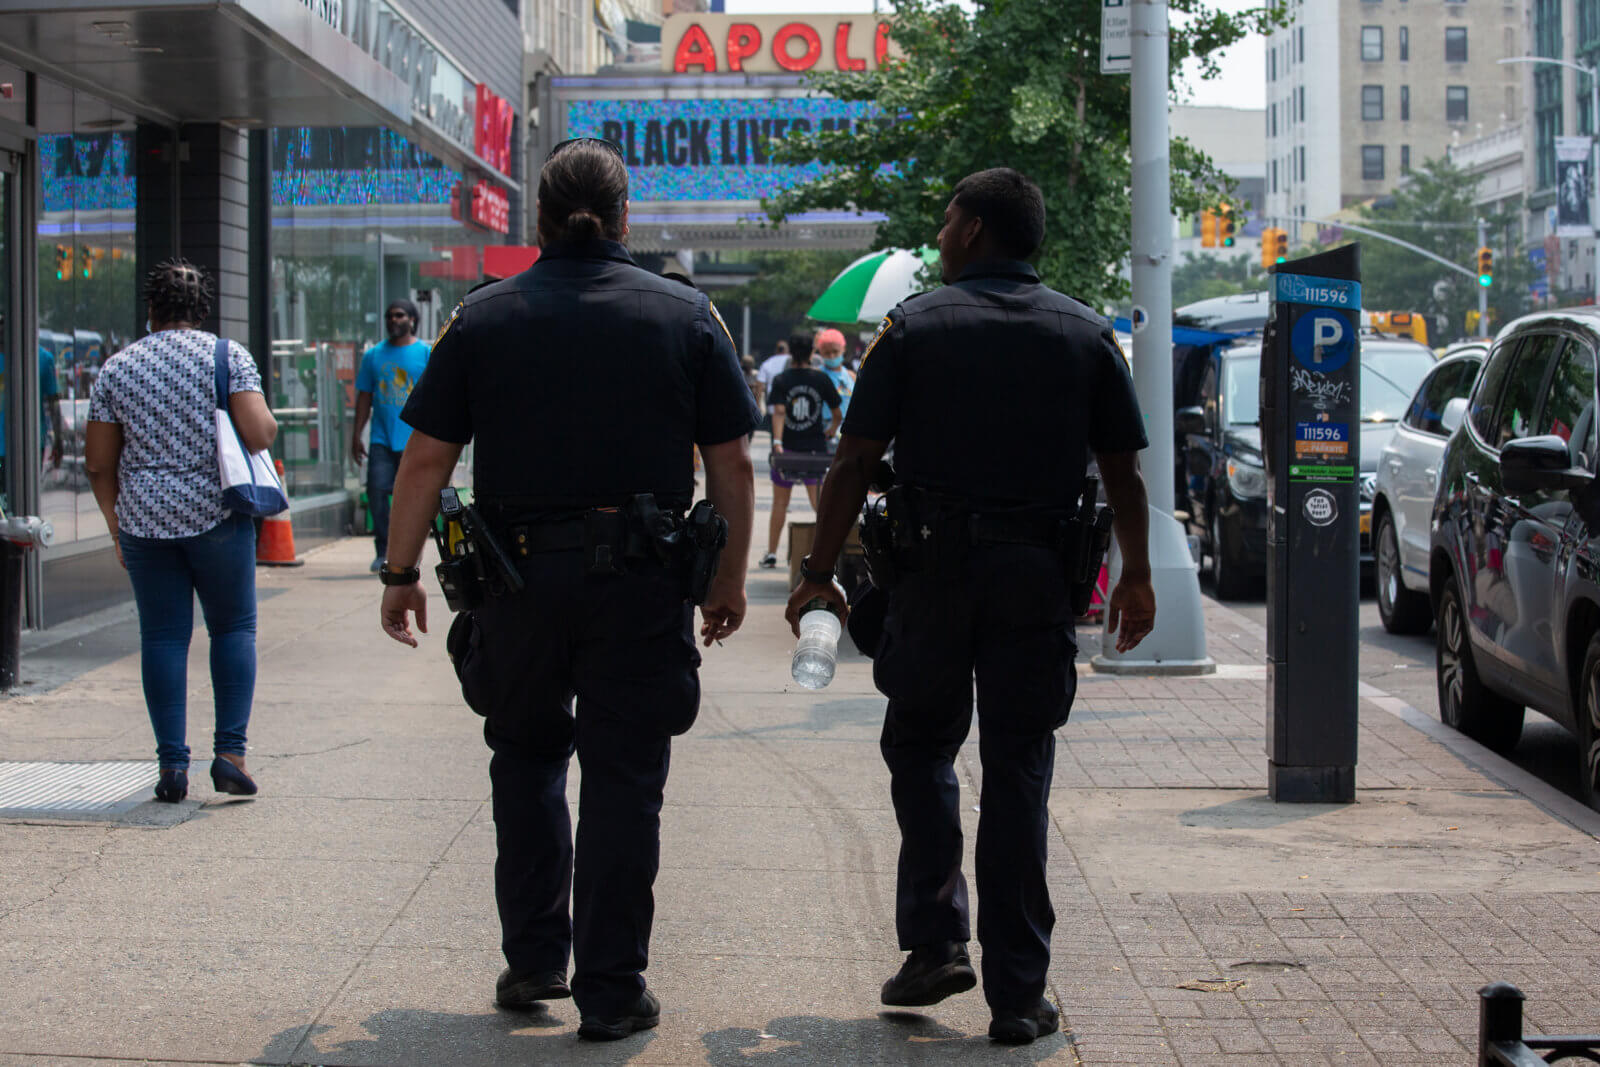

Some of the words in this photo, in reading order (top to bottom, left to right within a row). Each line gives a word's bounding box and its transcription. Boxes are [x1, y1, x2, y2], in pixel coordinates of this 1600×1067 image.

[674, 22, 906, 72] APOLL
[603, 119, 710, 166] BLACK
[1305, 288, 1348, 304] 111596
[1313, 317, 1343, 363] P
[1304, 427, 1341, 440] 111596
